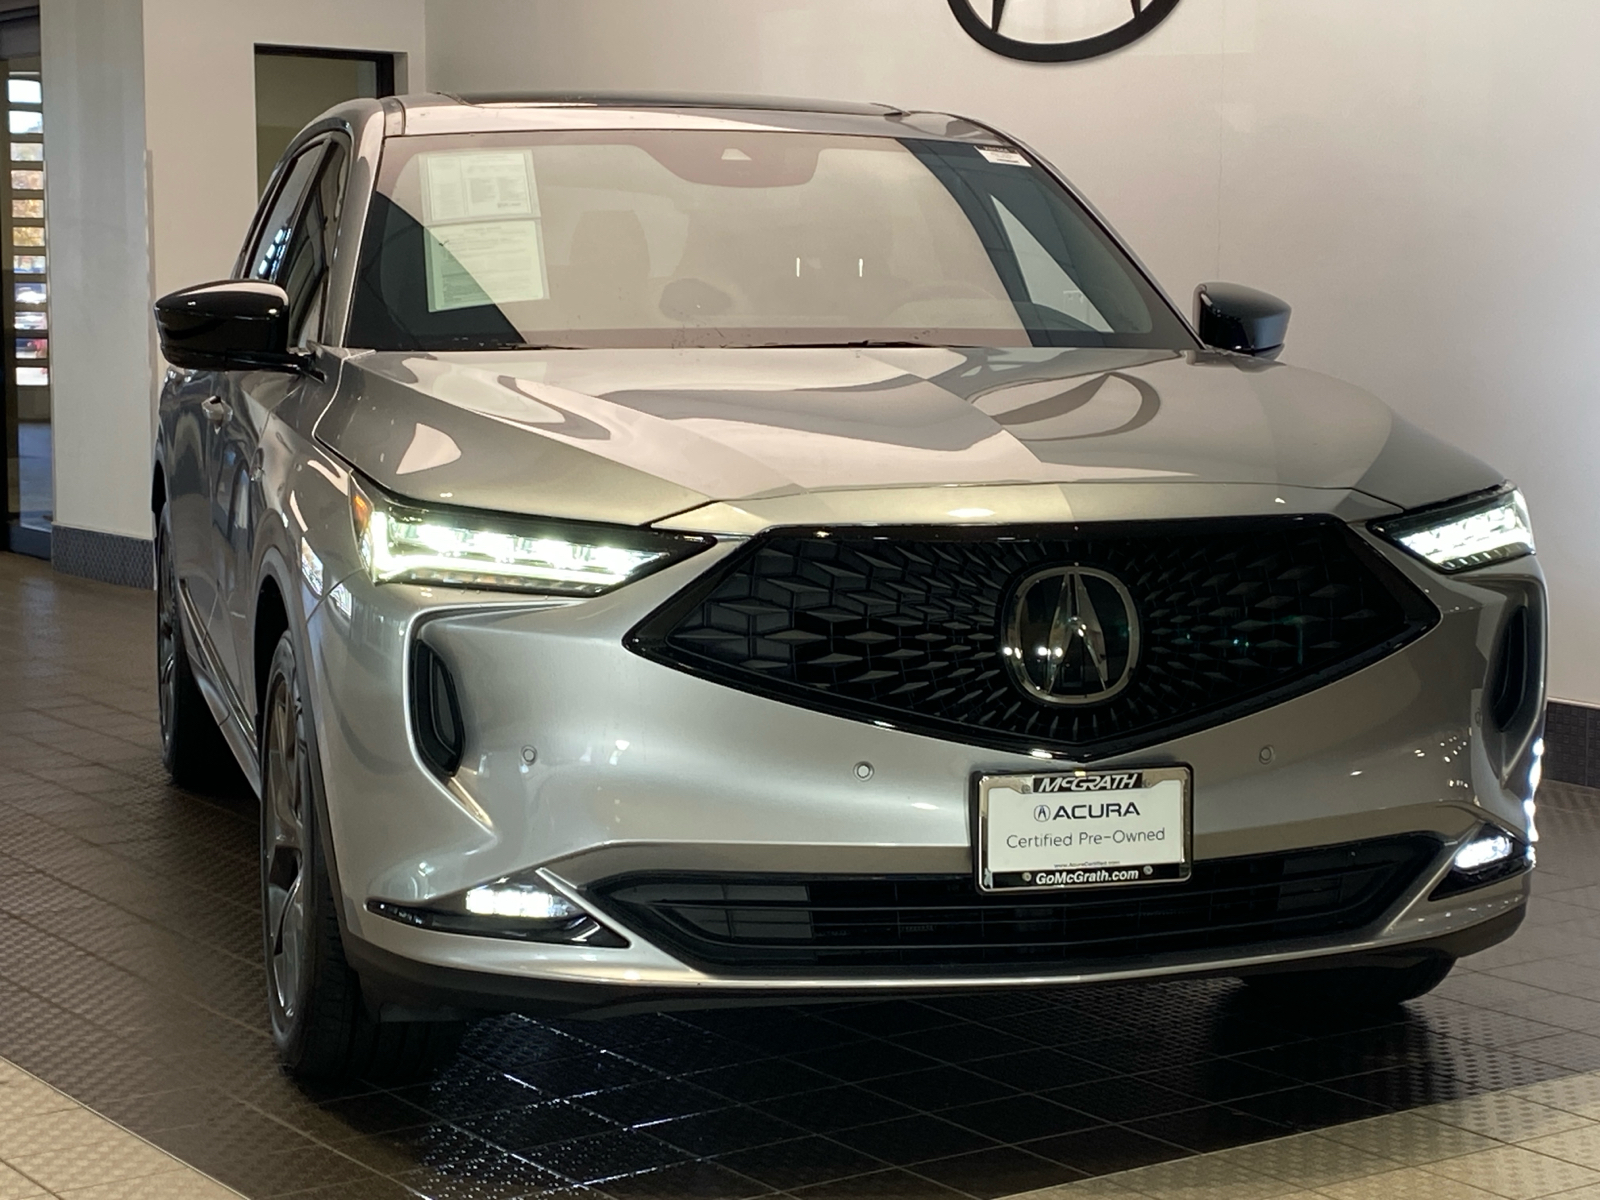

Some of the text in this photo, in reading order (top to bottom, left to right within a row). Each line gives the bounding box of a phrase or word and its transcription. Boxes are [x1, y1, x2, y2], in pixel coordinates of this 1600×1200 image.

[1052, 802, 1141, 820] ACURA
[1006, 827, 1166, 849] Certified Pre-Owned
[1035, 869, 1140, 886] GoMcGrath.com
